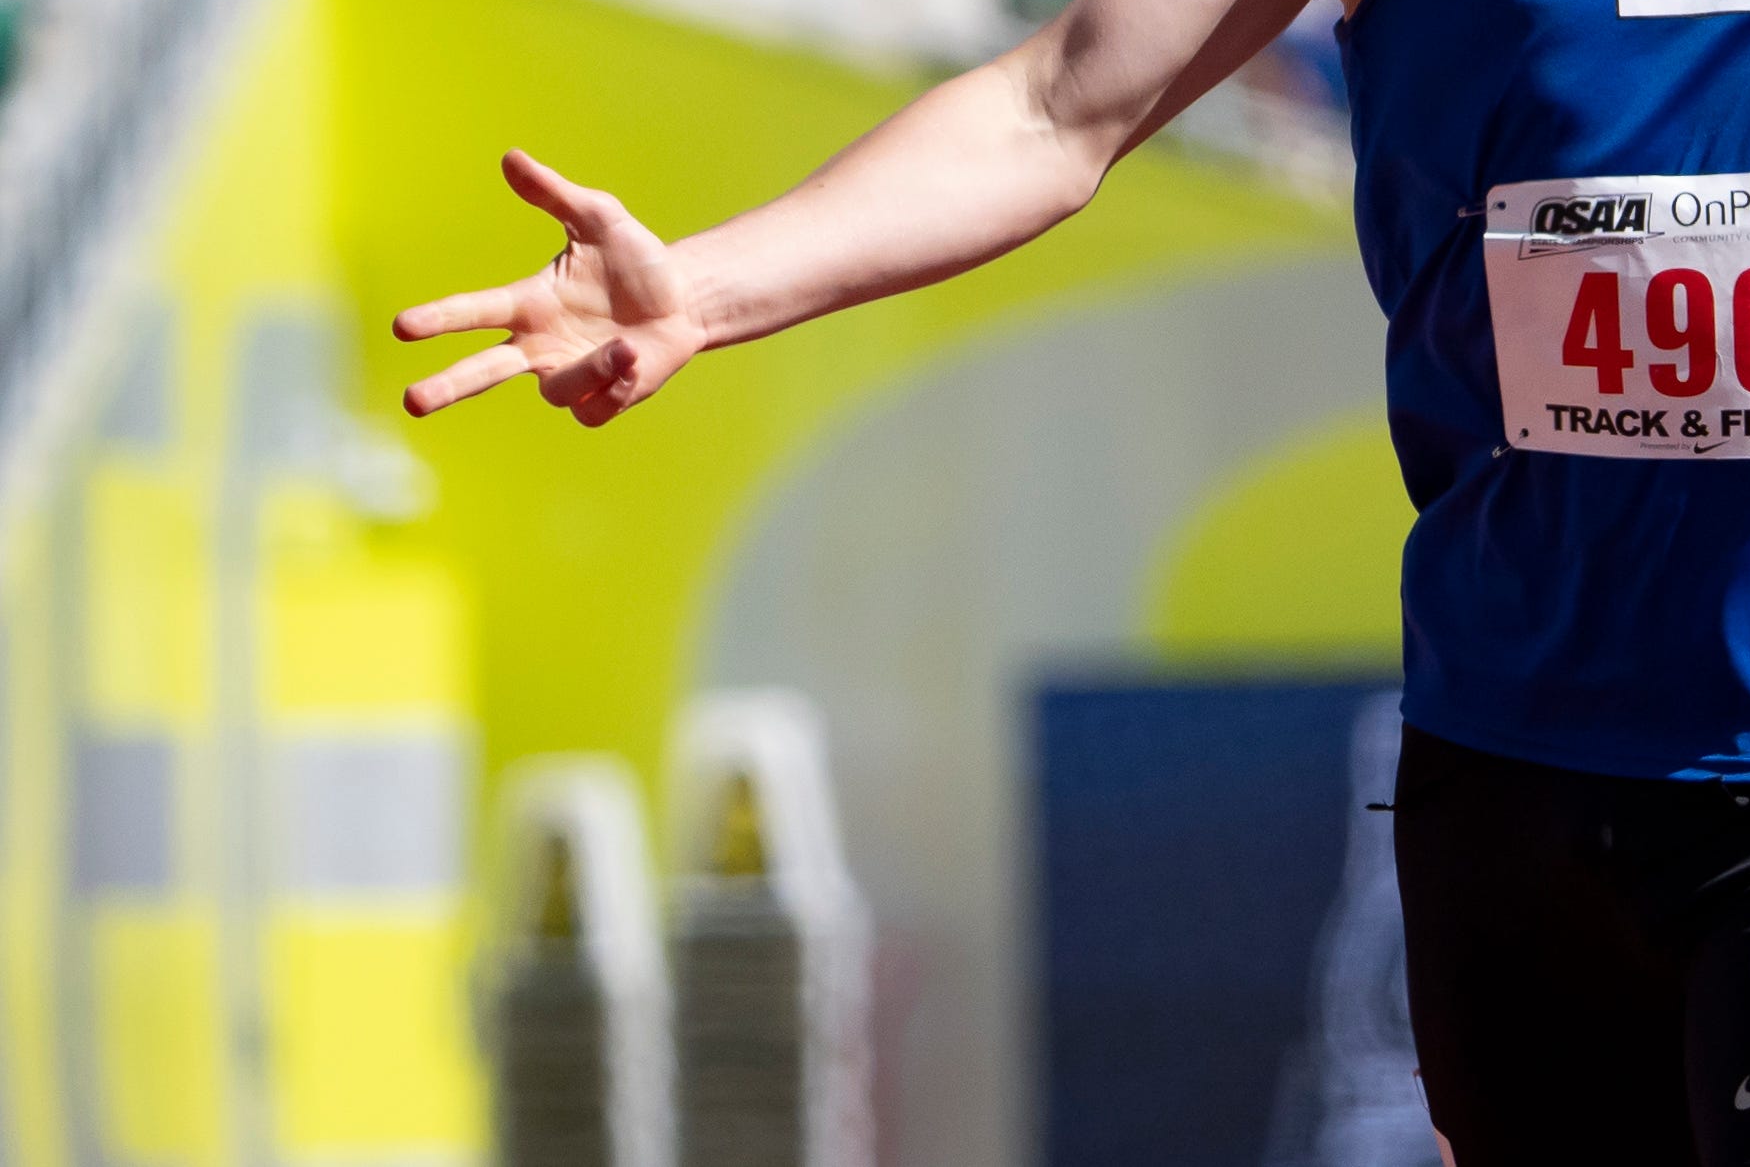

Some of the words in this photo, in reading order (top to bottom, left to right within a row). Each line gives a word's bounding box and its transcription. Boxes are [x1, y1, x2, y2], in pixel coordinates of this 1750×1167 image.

[1534, 197, 1647, 234] OSAA
[1672, 233, 1742, 244] COMMUNITY
[1546, 403, 1671, 437] TRACK
[1681, 409, 1710, 438] &
